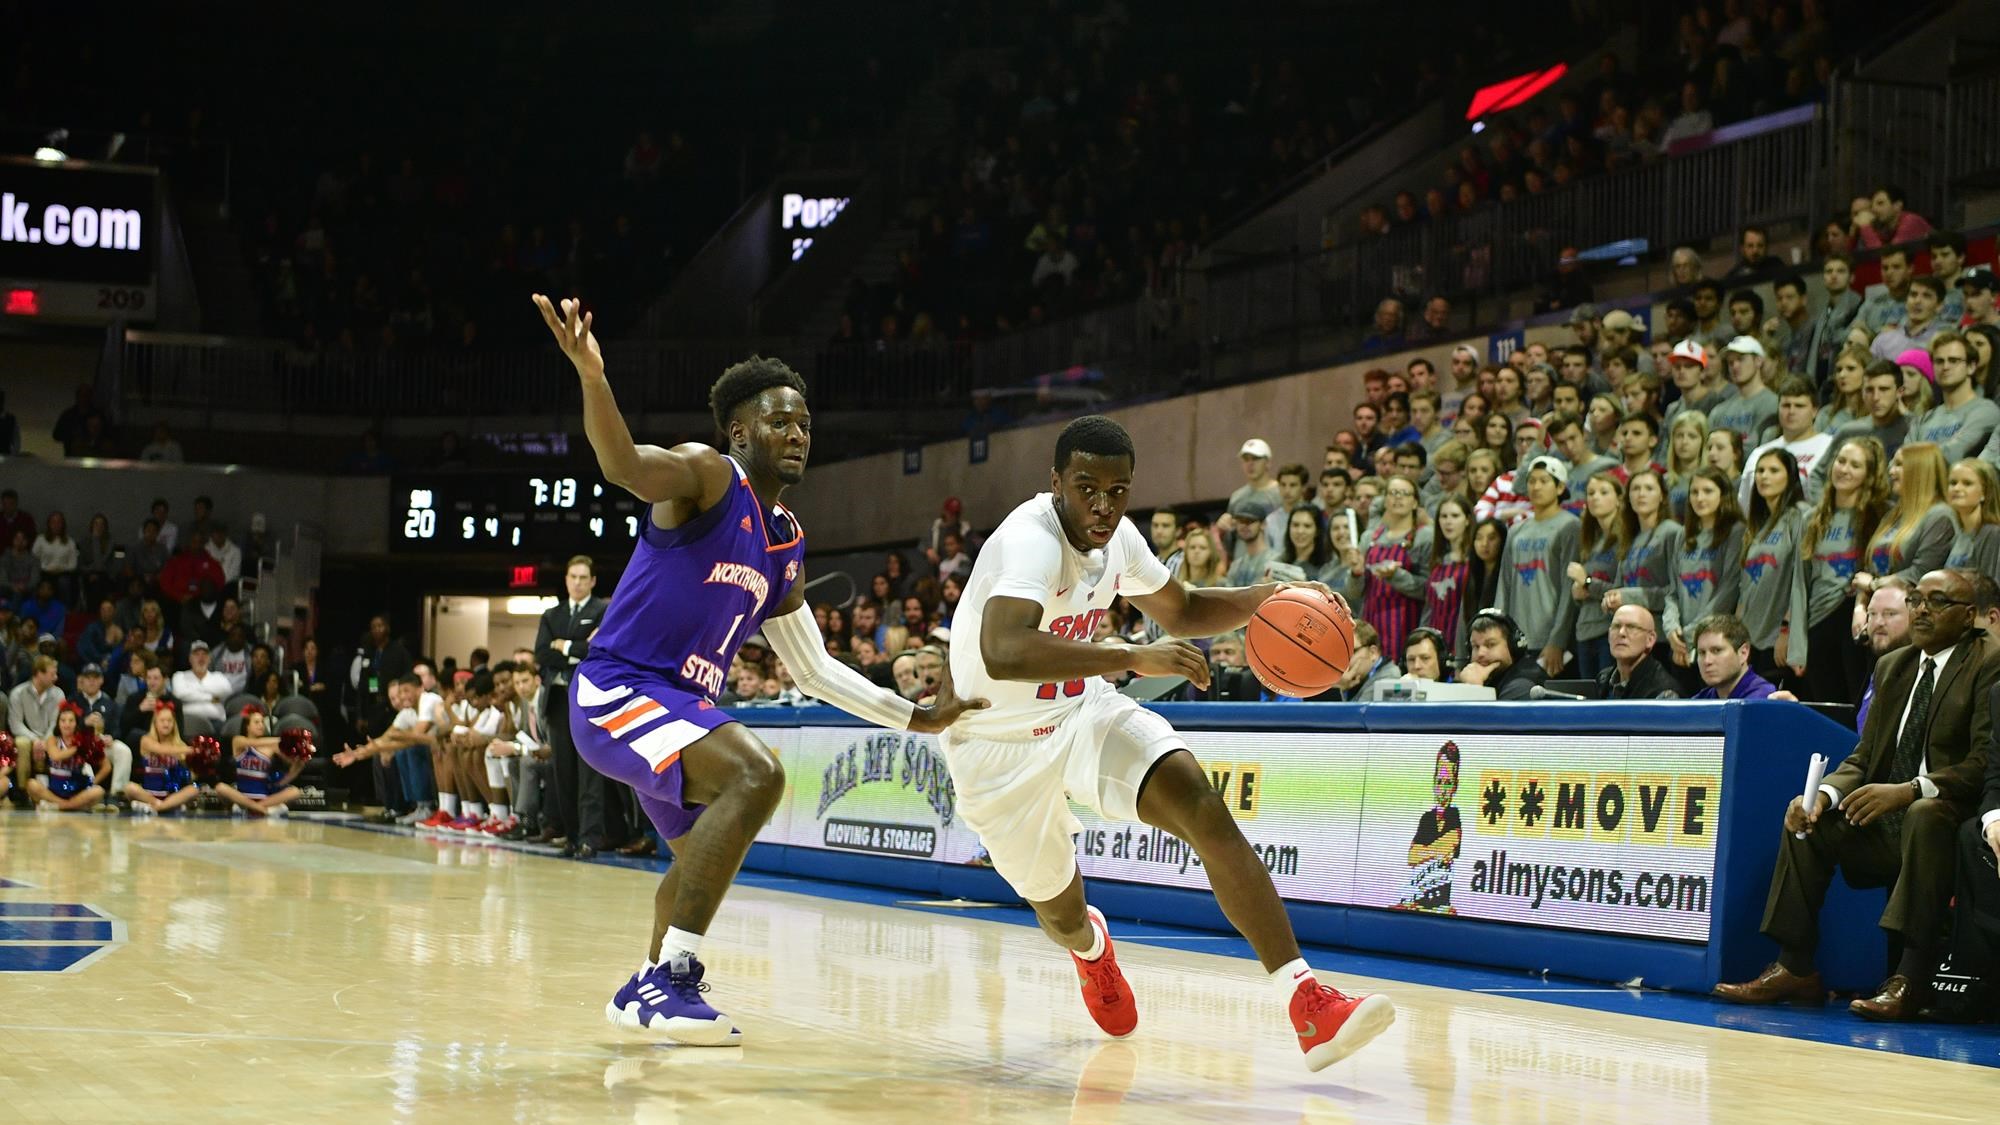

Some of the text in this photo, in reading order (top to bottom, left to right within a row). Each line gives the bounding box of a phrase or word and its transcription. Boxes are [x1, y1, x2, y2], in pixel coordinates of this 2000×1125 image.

[0, 191, 142, 251] k.com
[97, 287, 146, 310] 209
[529, 477, 577, 508] 7:13
[404, 508, 436, 538] 20
[462, 516, 475, 539] 5
[484, 517, 499, 538] 4
[589, 517, 604, 538] 4
[716, 613, 745, 656] 1
[1033, 725, 1056, 737] SMU
[861, 731, 900, 784] MY
[826, 821, 934, 854] MOVING & STORAGE
[1084, 829, 1105, 857] us
[1112, 825, 1132, 860] at
[1470, 849, 1707, 912] allmysons.com
